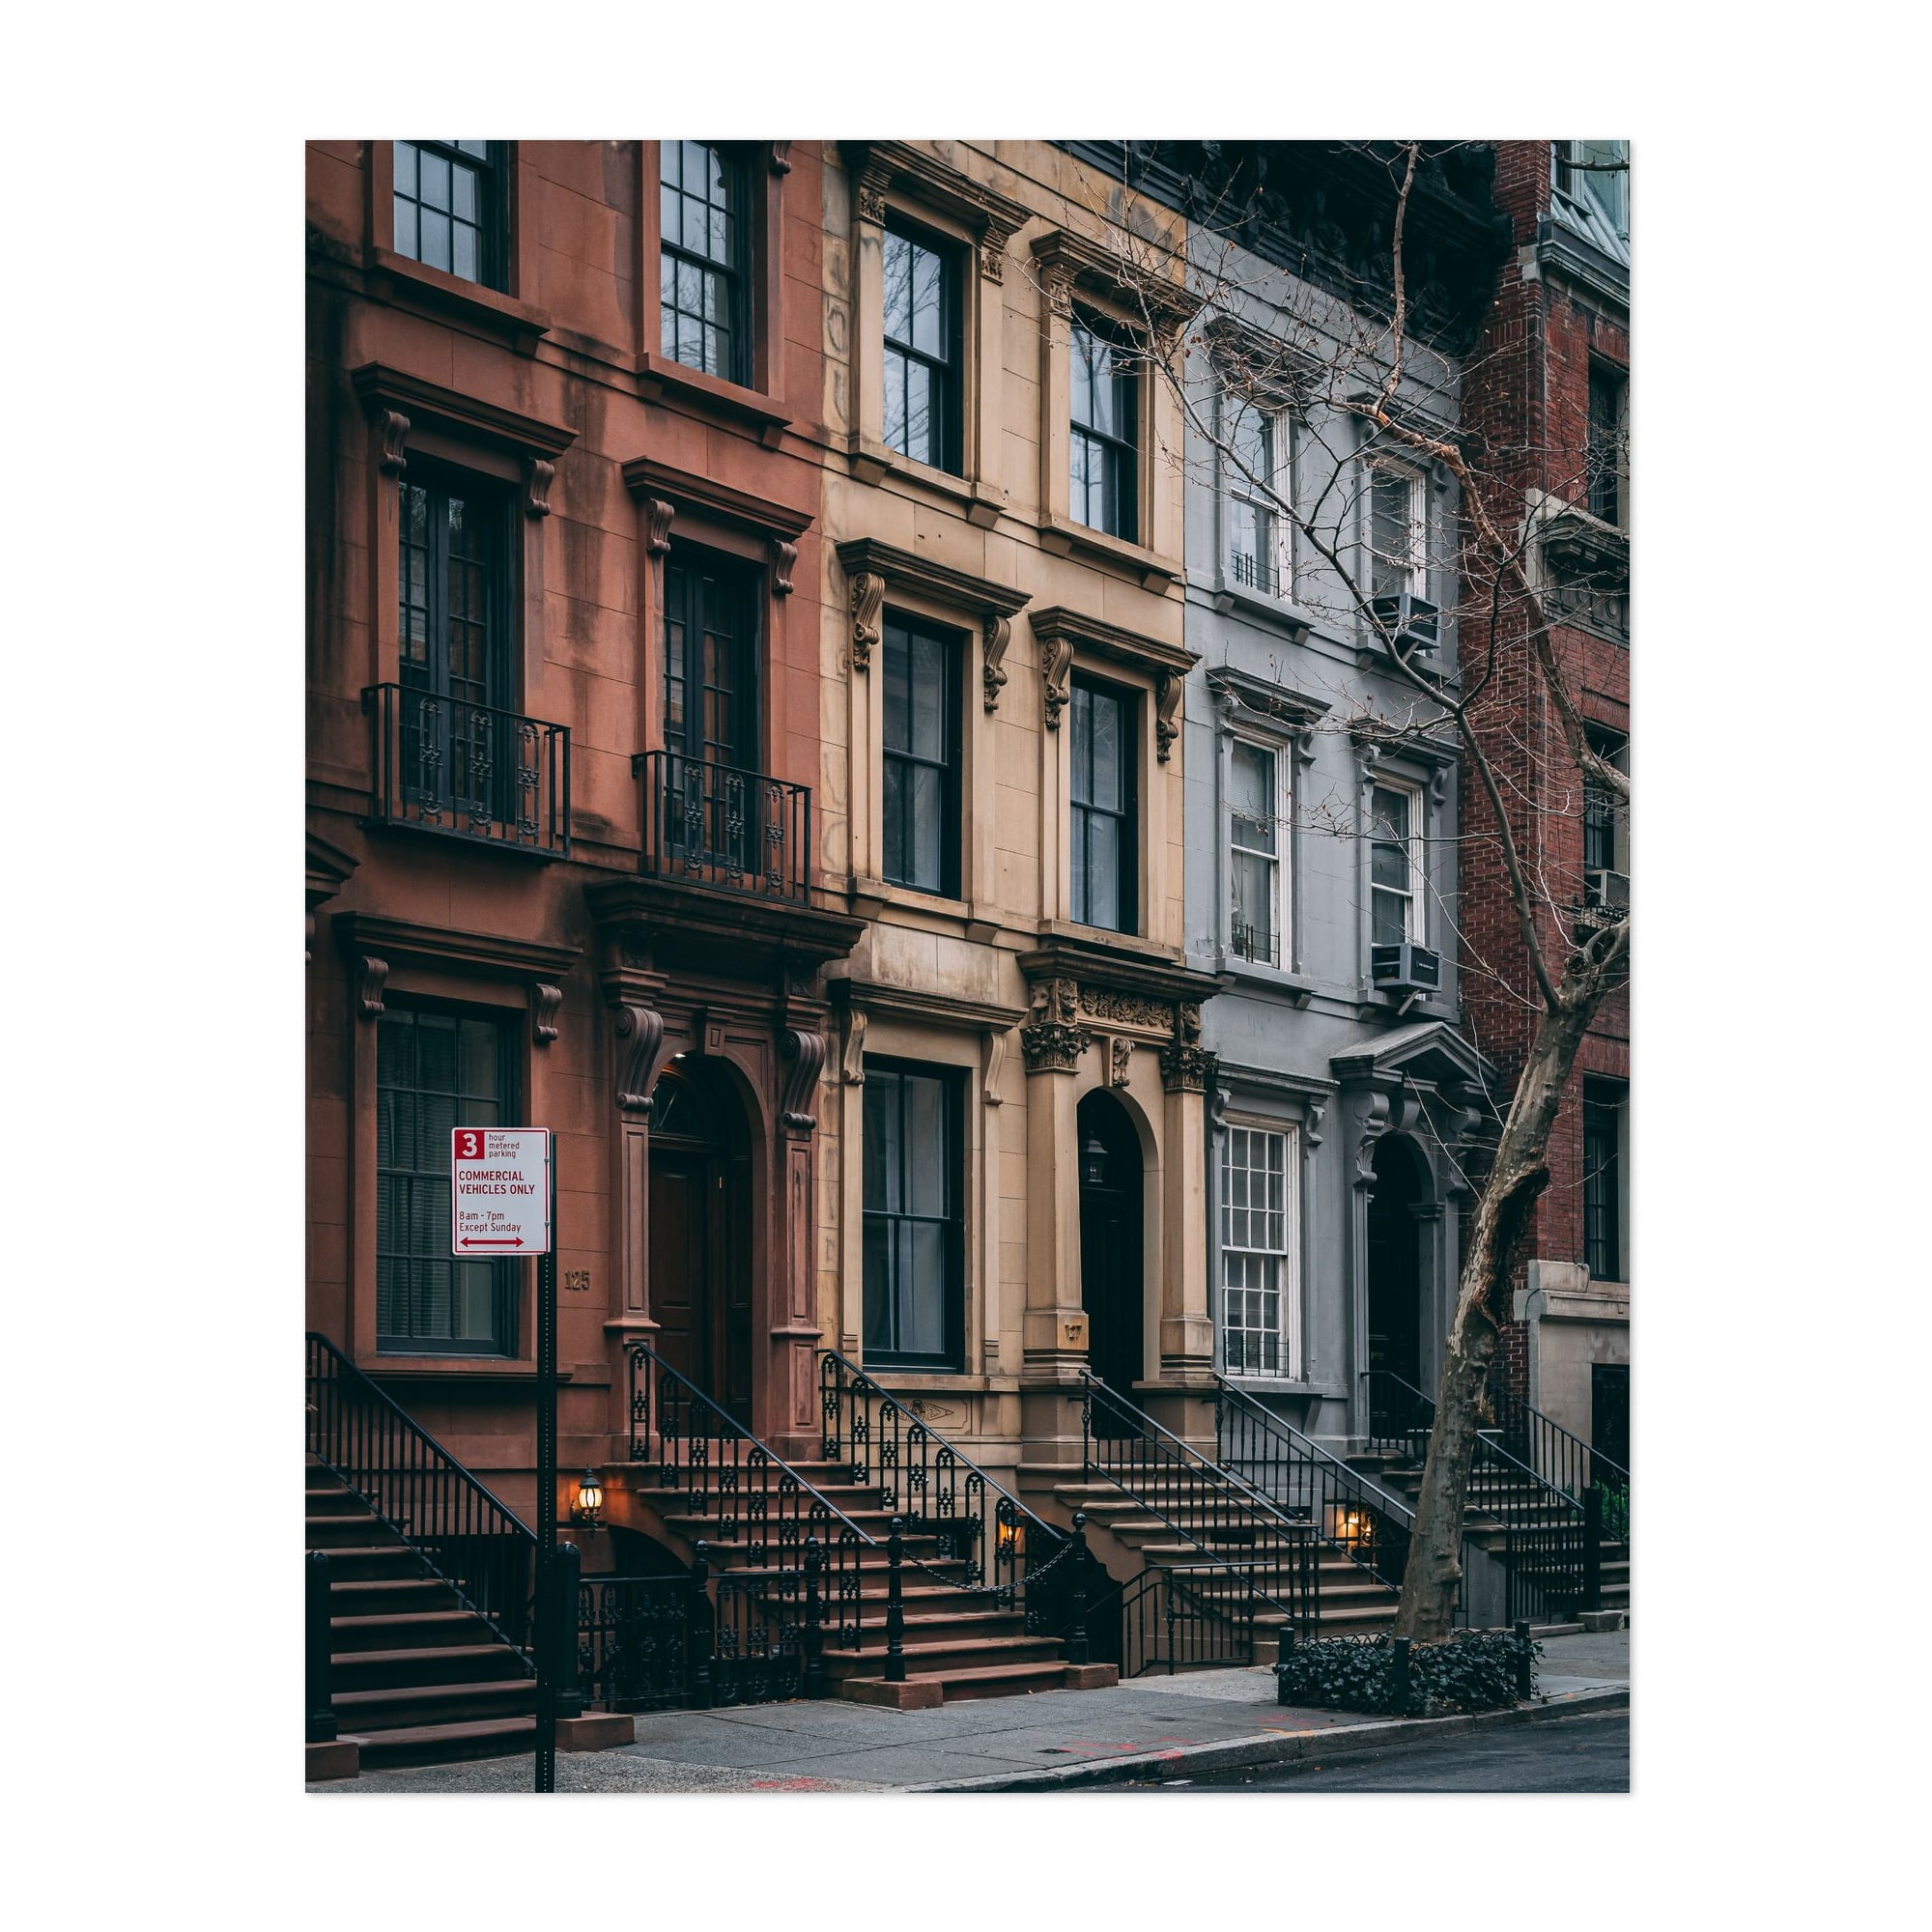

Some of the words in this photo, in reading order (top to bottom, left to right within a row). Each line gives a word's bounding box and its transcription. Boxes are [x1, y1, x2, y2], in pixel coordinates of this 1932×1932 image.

[462, 1133, 477, 1156] 3
[459, 1171, 525, 1181] COMMERCIAL
[459, 1184, 507, 1195] VEHICLES
[509, 1184, 535, 1195] ONLY
[486, 1211, 504, 1222] 7pm
[459, 1223, 488, 1233] Except
[491, 1223, 522, 1234] Sunday
[565, 1270, 590, 1291] 125
